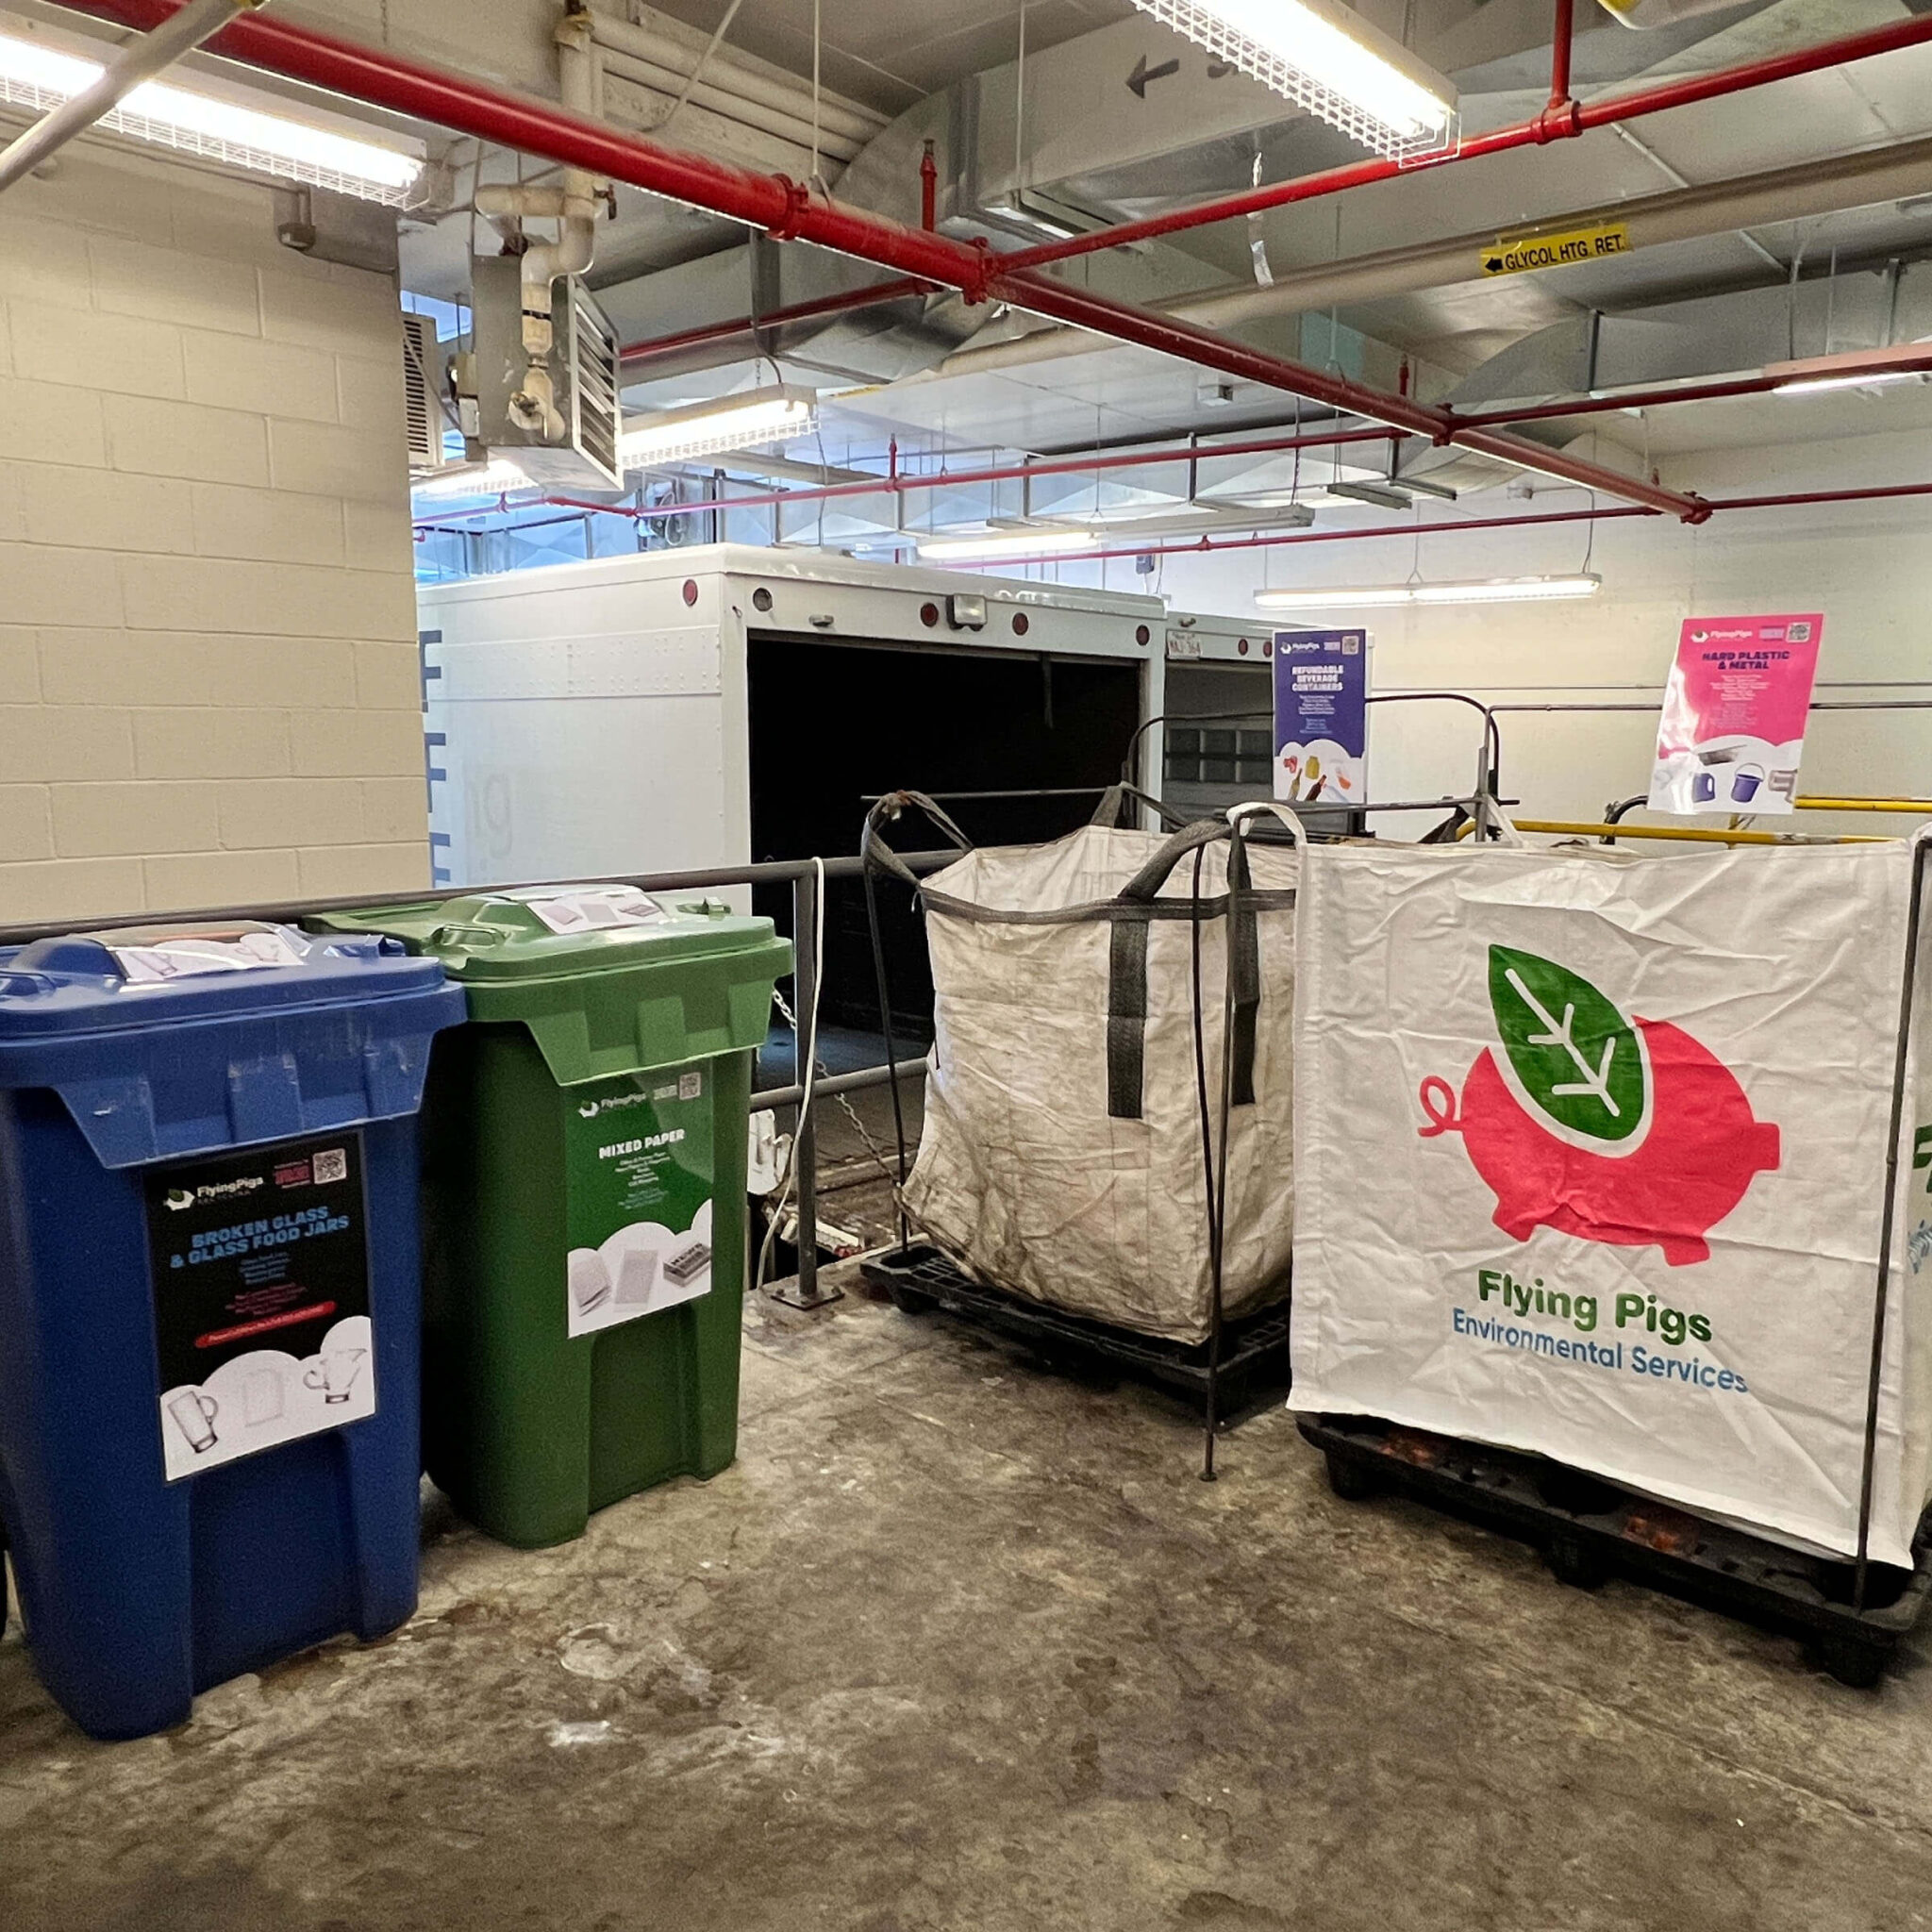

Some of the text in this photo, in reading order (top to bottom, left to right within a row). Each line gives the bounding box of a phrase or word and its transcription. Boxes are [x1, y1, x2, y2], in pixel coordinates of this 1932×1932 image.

[1505, 246, 1557, 270] GLYCOL
[1594, 234, 1624, 254] RET.
[1703, 651, 1790, 660] HARD PLASTIC
[1718, 661, 1769, 670] & METAL
[599, 1129, 685, 1159] MIXED PAPER
[170, 1216, 350, 1268] & GLASS FOOD JARS
[192, 1206, 328, 1248] BROKEN GLASS
[1478, 1270, 1712, 1345] Flying Pigs
[1453, 1307, 1748, 1393] Environmental Services
